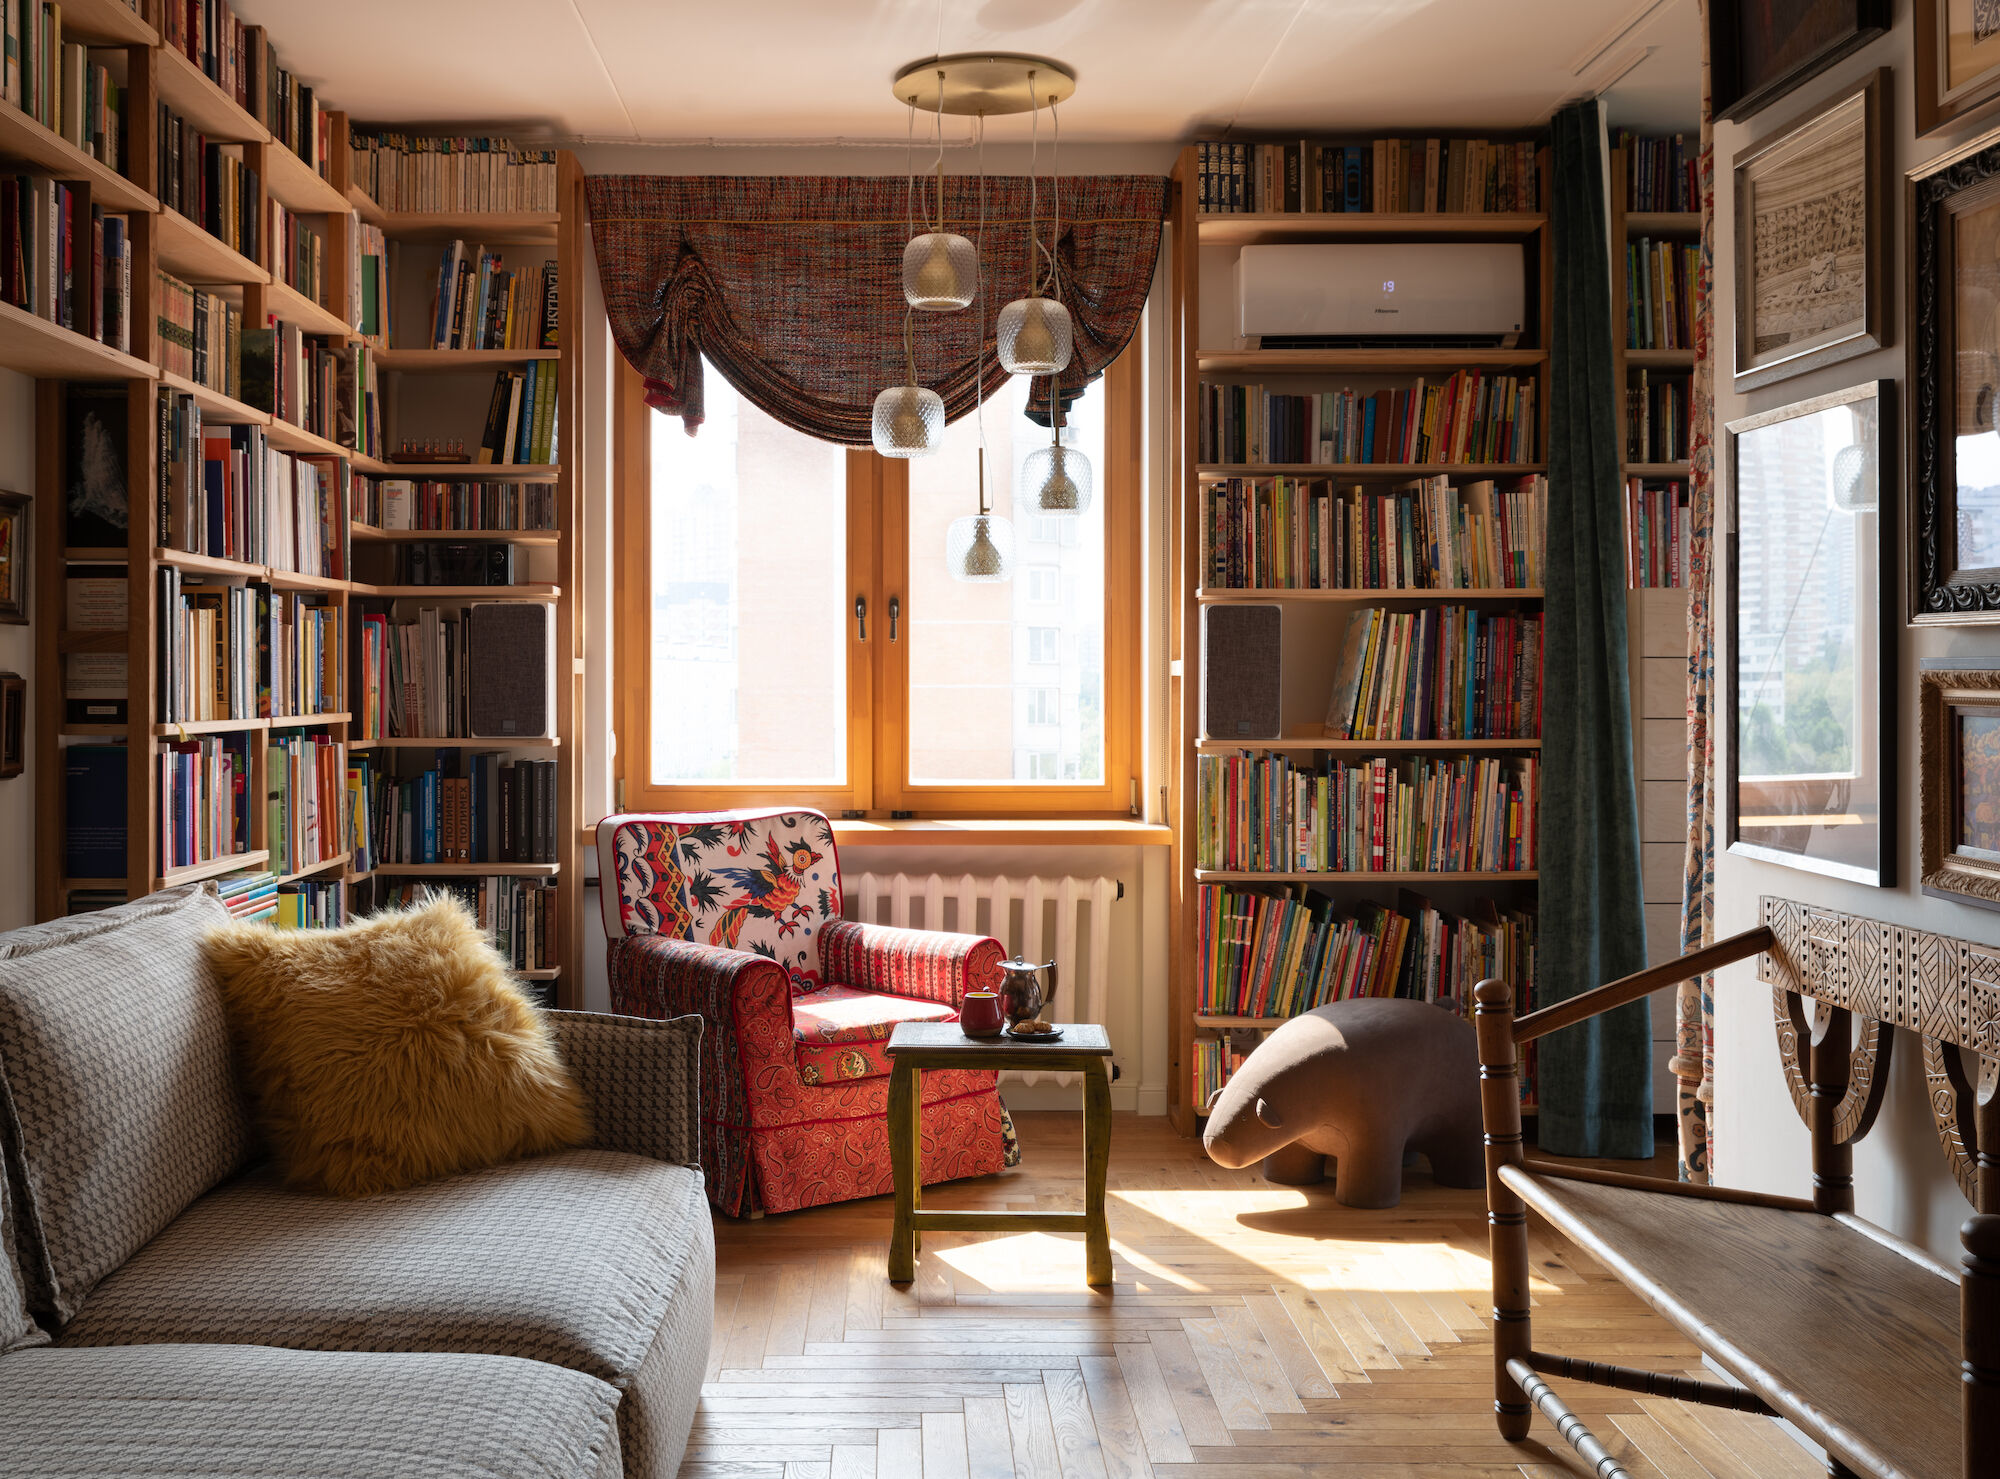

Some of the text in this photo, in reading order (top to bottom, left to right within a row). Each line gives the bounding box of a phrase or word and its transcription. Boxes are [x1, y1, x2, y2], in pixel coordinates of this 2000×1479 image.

[547, 274, 558, 327] ENGLISH
[1383, 280, 1395, 293] 19
[445, 785, 453, 842] ПОЛИМЕХ
[458, 786, 467, 843] ПОЛИМЕХ
[446, 848, 452, 857] 1
[460, 849, 467, 858] 2
